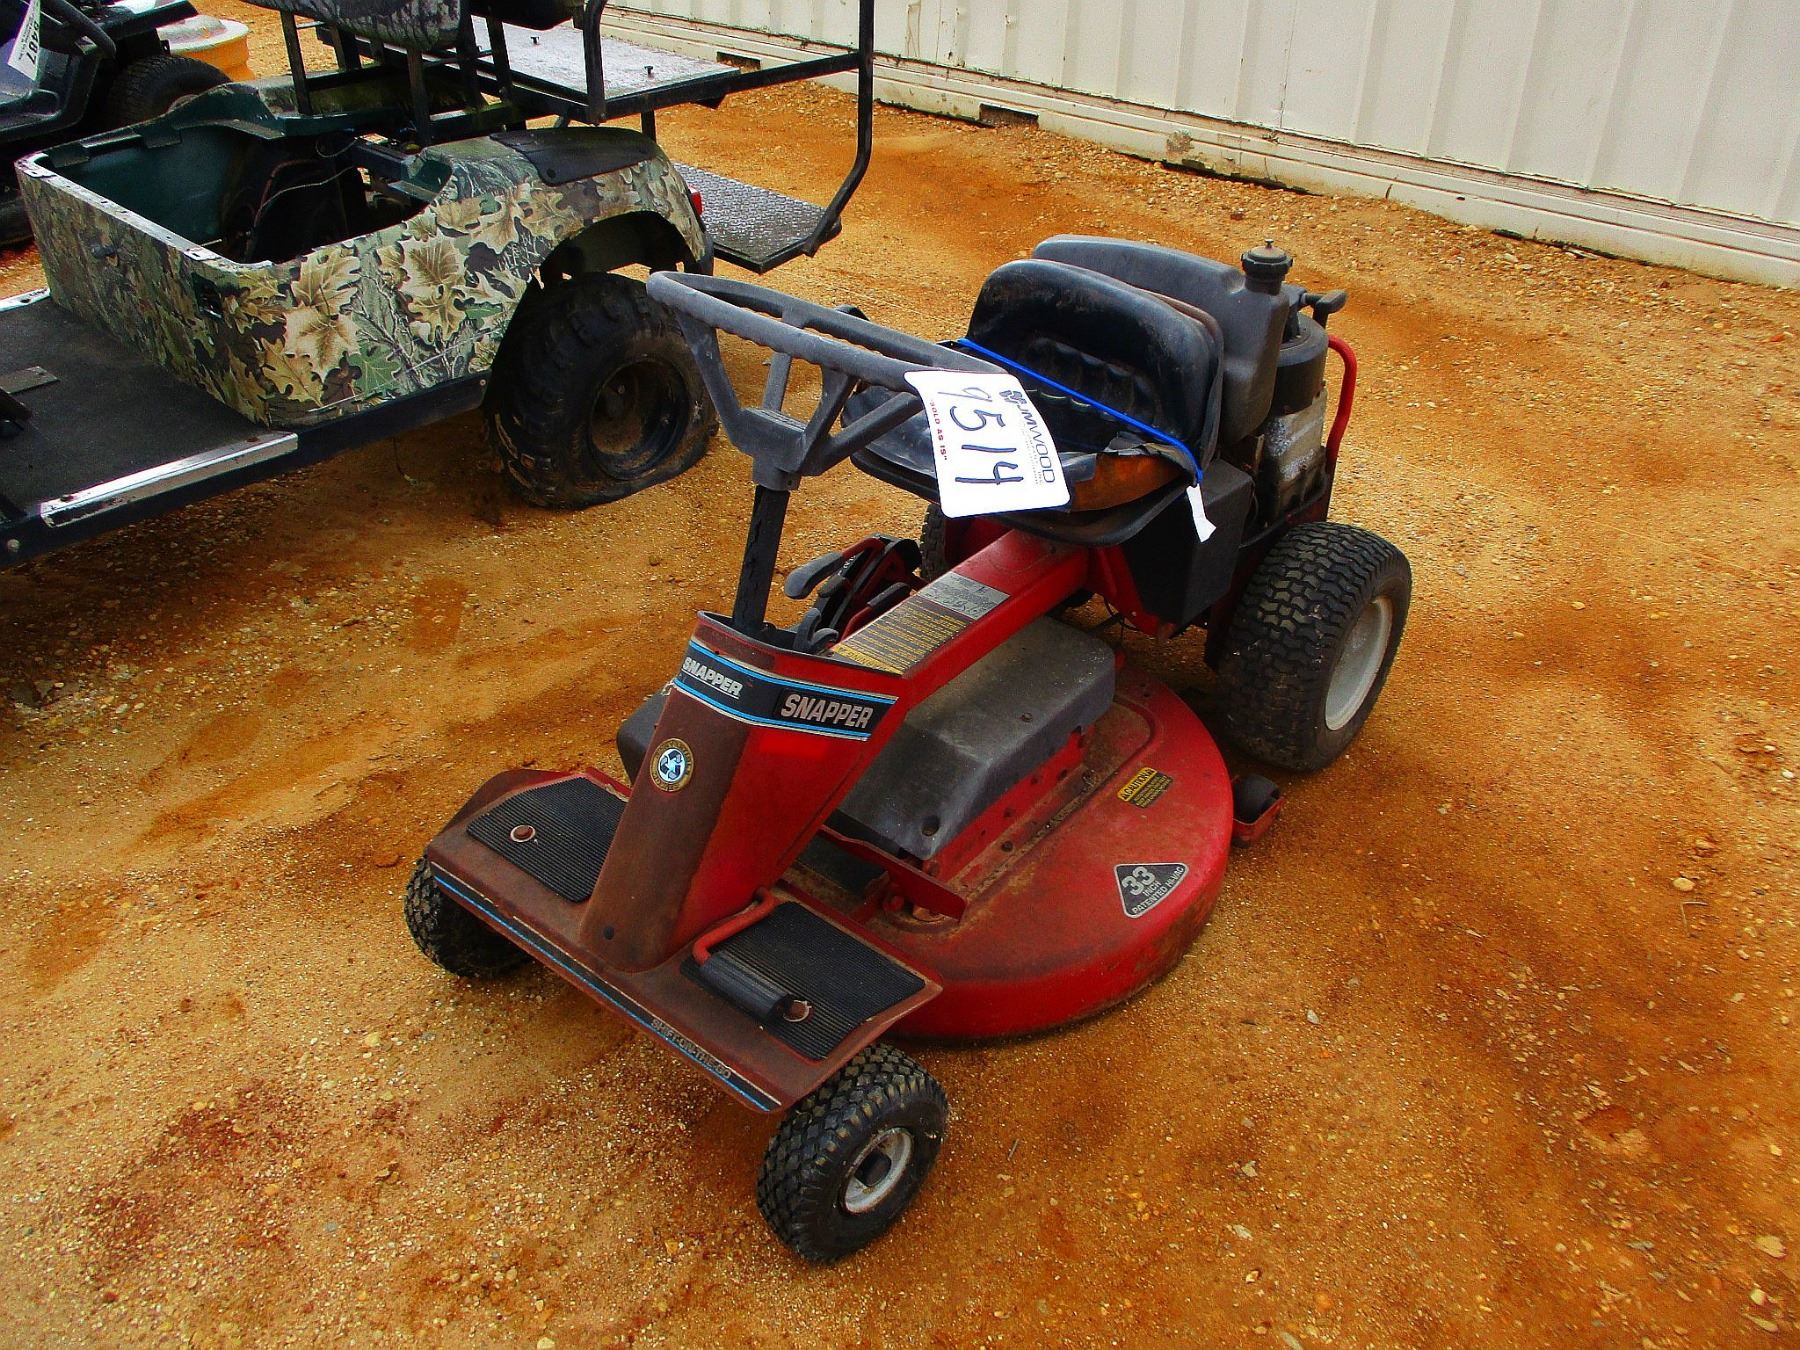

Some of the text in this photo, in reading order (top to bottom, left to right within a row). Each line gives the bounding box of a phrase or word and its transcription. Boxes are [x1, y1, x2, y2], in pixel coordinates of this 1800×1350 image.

[937, 428, 944, 441] AS
[937, 387, 1024, 485] 9514
[682, 656, 744, 697] SNAPPER
[780, 693, 874, 730] SNAPPER
[1123, 772, 1150, 795] CAUTION
[1121, 866, 1156, 896] 33
[1142, 879, 1162, 897] INCH
[1131, 885, 1168, 914] PATENTED
